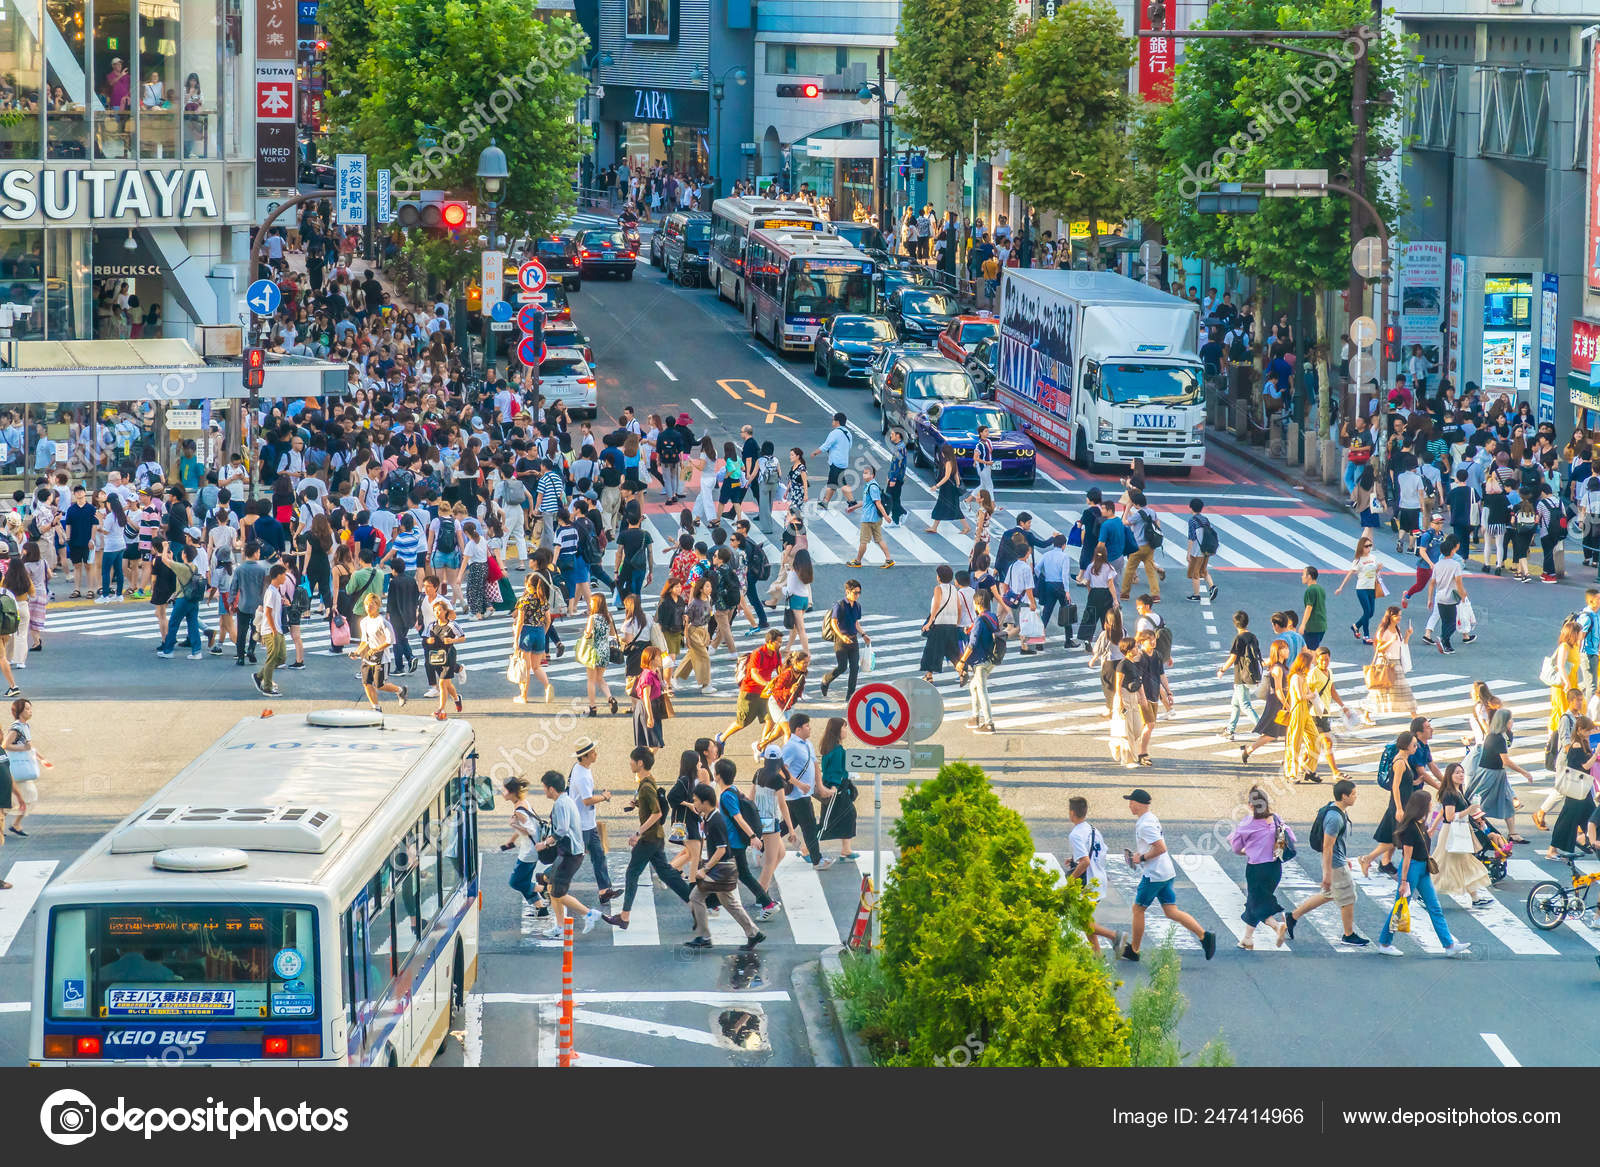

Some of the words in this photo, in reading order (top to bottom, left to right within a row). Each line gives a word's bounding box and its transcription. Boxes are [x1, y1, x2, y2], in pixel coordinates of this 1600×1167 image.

[1149, 36, 1168, 73] 銀行
[256, 67, 295, 76] TSUTAYA
[261, 86, 289, 114] 本
[634, 89, 672, 120] ZARA
[259, 147, 291, 157] WIRED
[1, 168, 219, 220] SUTAYA
[340, 169, 348, 197] Shibuya
[349, 160, 362, 220] 渋谷駅前
[380, 172, 389, 220] スクランブル式
[340, 198, 348, 210] Sta
[1133, 414, 1177, 428] EXILE
[850, 755, 905, 769] ここから
[105, 1030, 157, 1045] KEIO
[158, 1030, 207, 1045] BUS
